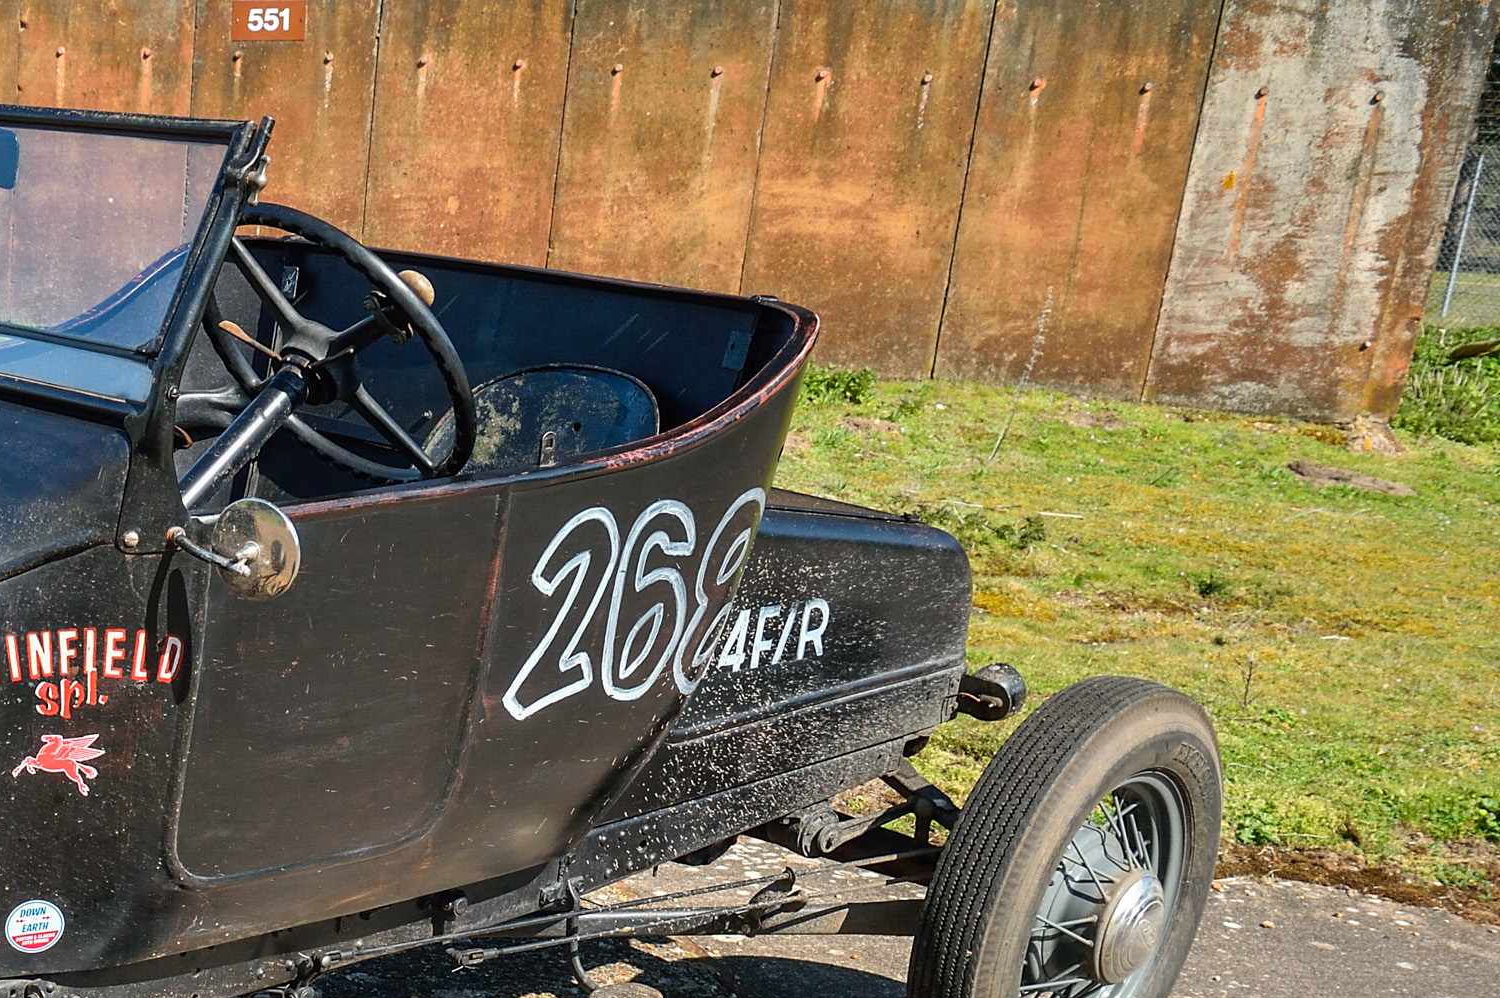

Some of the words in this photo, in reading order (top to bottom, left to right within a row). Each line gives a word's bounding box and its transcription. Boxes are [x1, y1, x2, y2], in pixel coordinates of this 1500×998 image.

[247, 7, 290, 32] 551
[502, 486, 766, 722] 268
[20, 906, 47, 918] DOWN
[22, 921, 49, 933] EARTH
